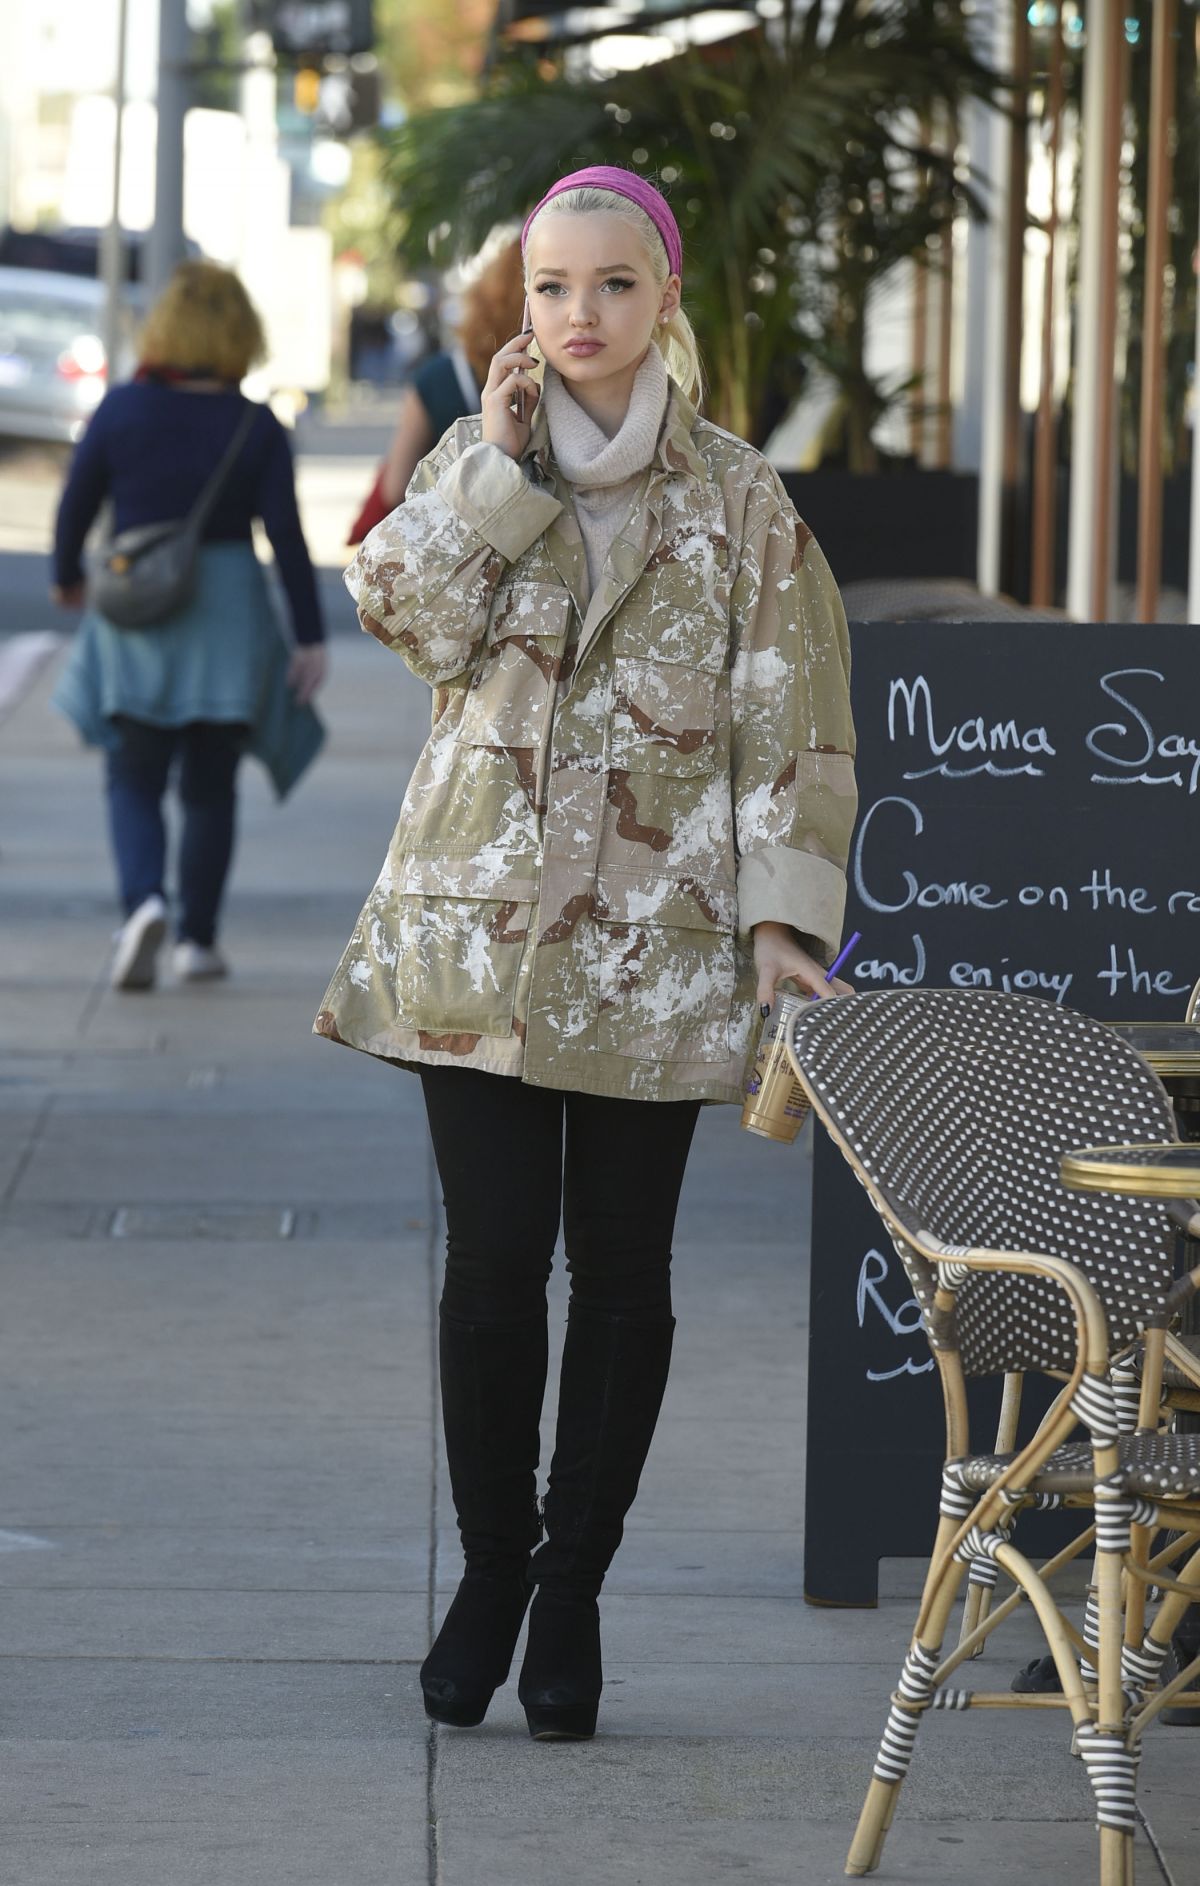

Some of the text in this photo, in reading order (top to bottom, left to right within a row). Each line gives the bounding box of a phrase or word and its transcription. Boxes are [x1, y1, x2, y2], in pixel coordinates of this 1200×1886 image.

[888, 675, 1056, 756] Mama
[855, 797, 1009, 913] Come
[1019, 886, 1068, 911] on
[1080, 869, 1157, 913] the
[855, 934, 1191, 1003] and enjoy the
